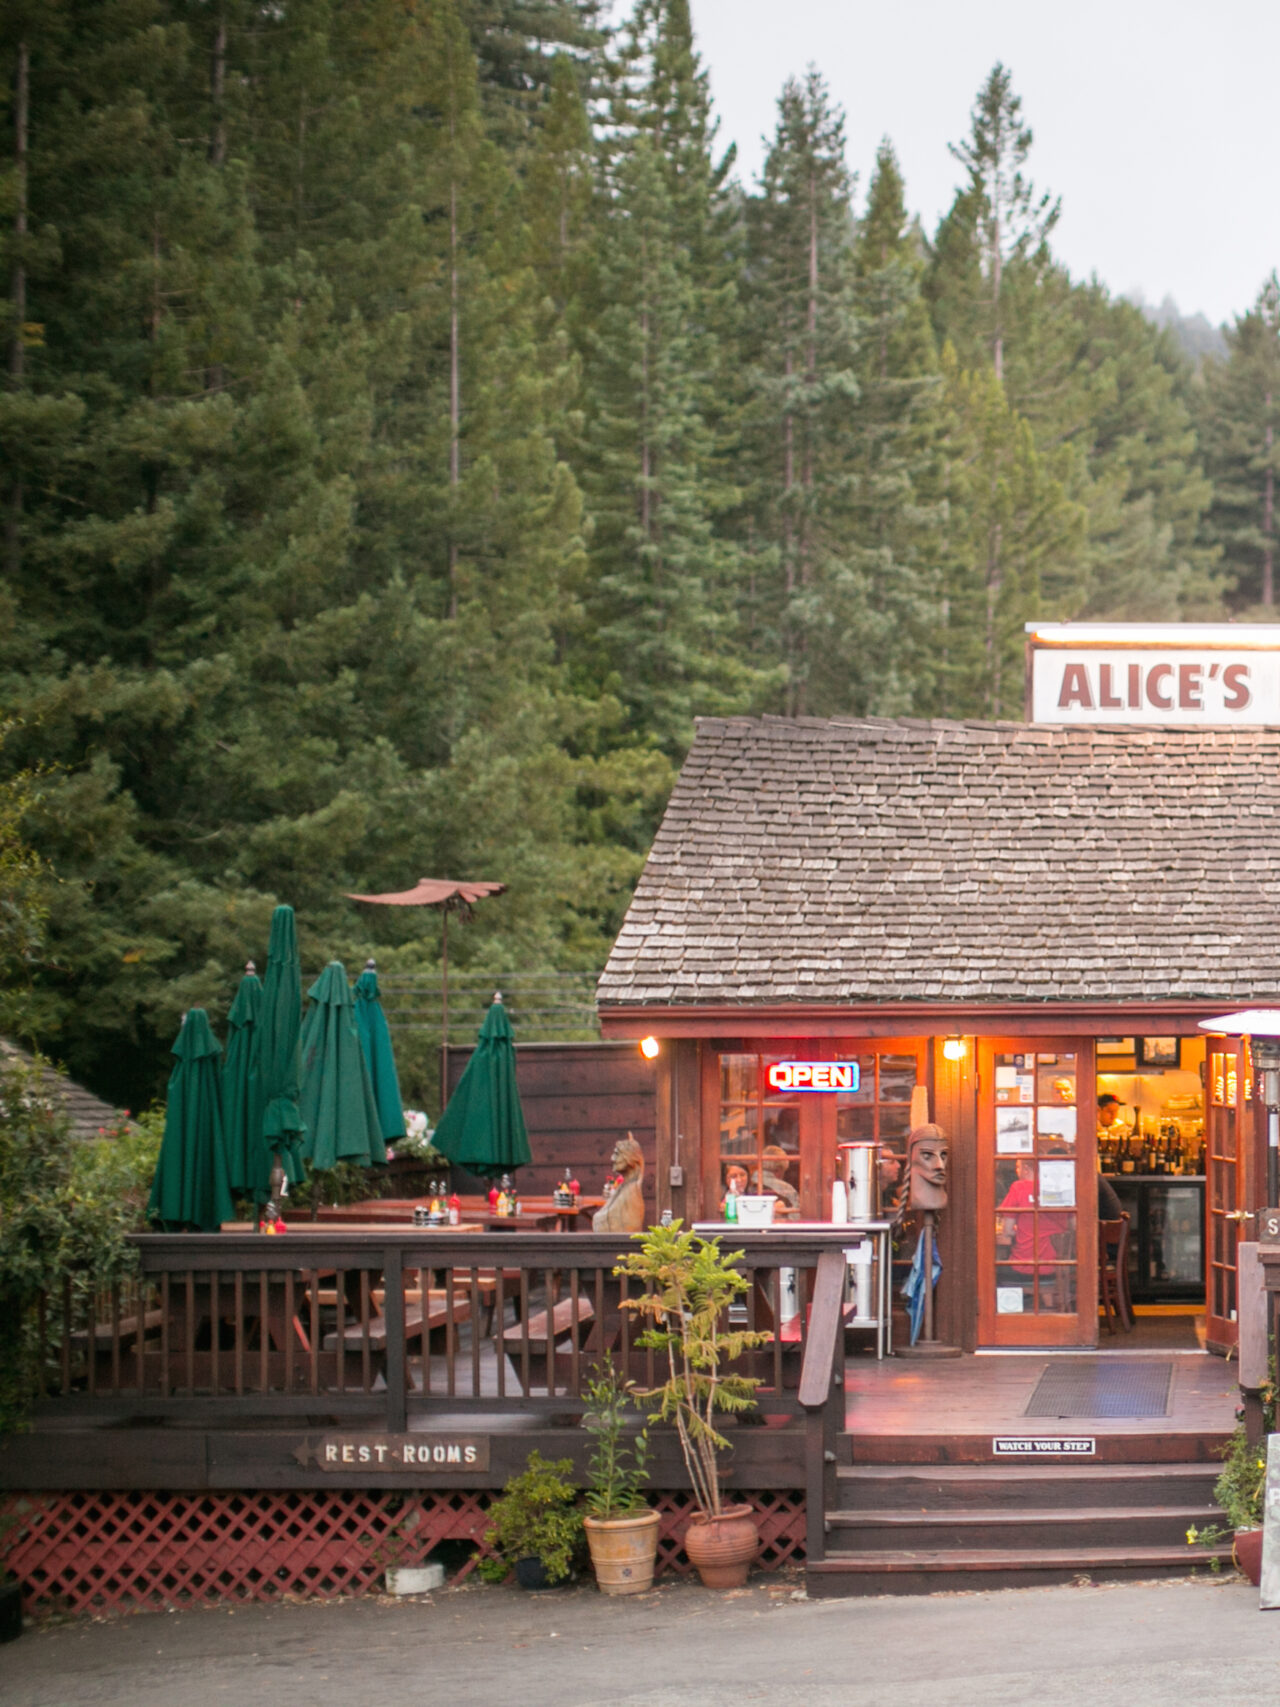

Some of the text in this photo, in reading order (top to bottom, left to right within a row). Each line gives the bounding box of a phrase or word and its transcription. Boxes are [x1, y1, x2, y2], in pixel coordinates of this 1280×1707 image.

[1057, 662, 1251, 711] ALICE'S
[769, 1065, 852, 1088] OPEN
[325, 1444, 477, 1463] REST ROOMS
[998, 1441, 1090, 1451] WATCH YOUR STEP
